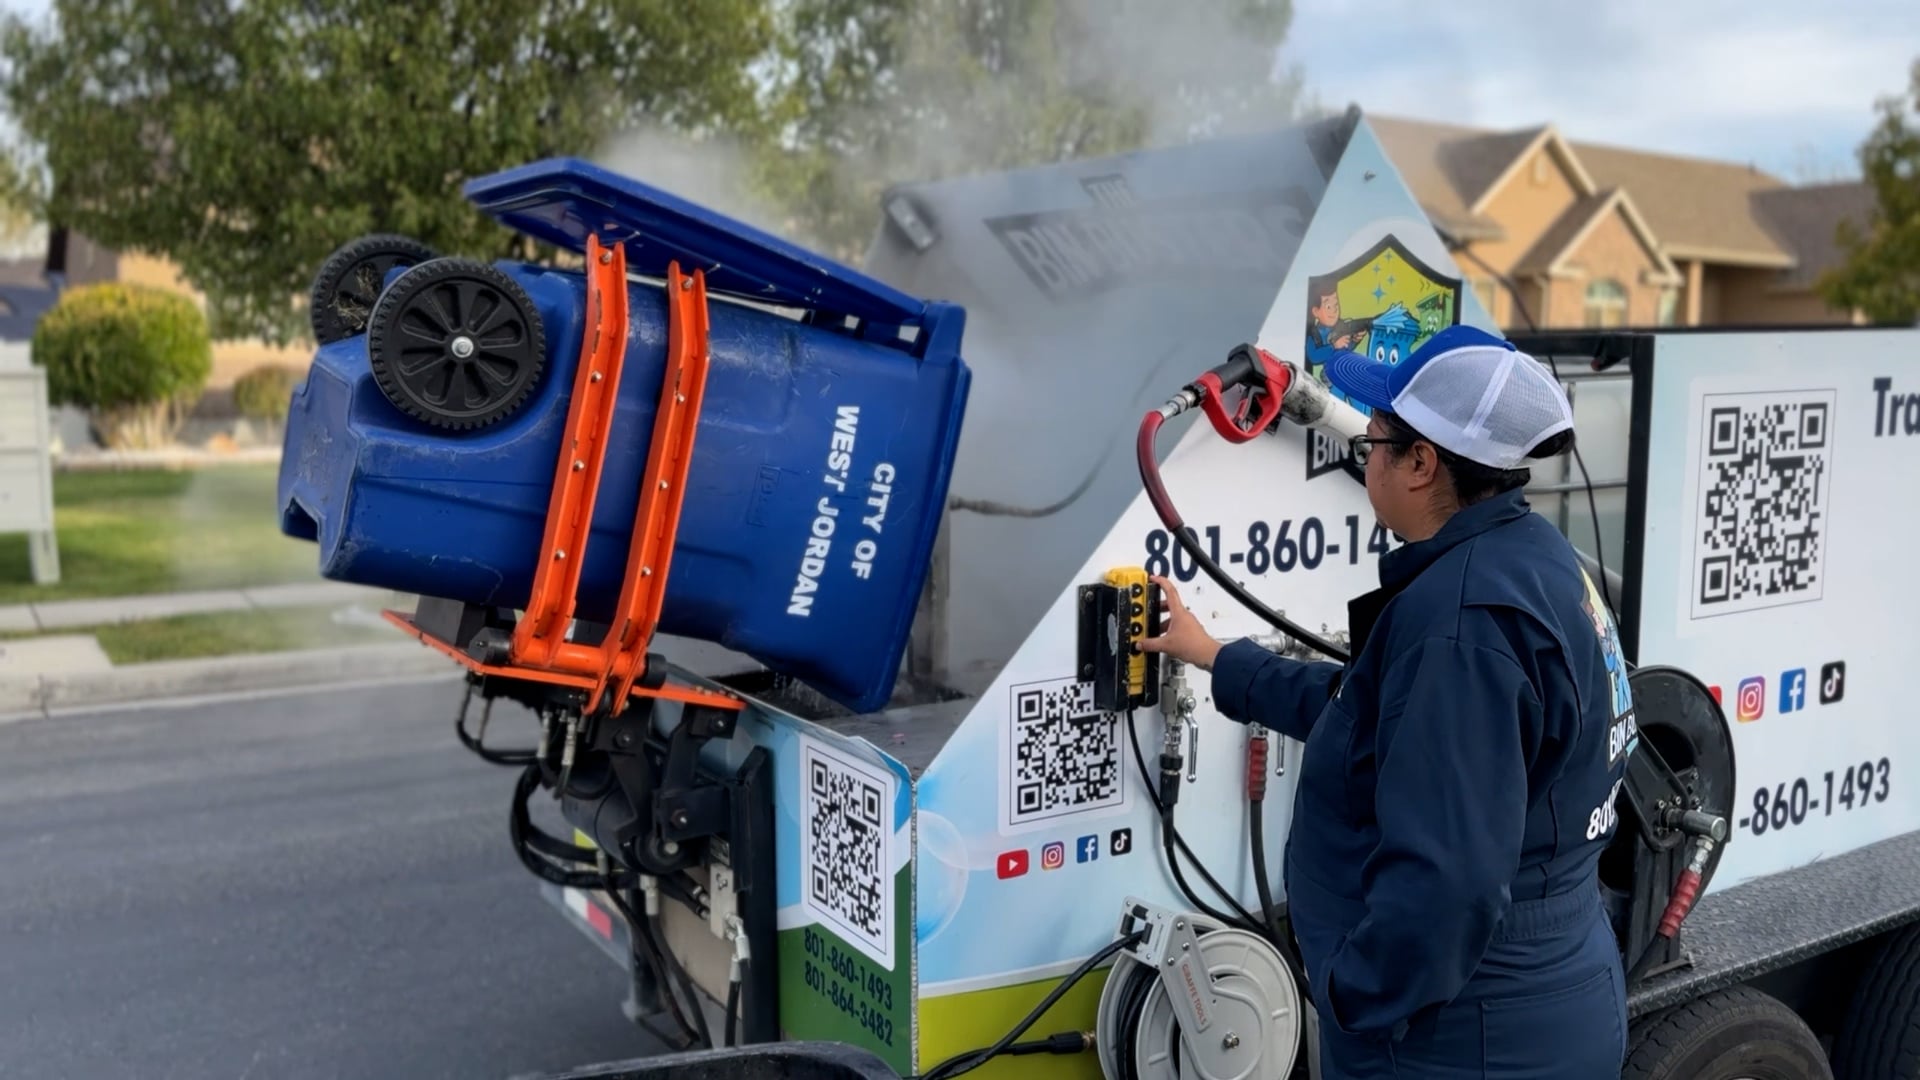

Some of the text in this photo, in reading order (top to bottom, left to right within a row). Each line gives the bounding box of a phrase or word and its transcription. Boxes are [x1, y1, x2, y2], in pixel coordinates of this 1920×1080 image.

[1006, 221, 1106, 291] BIN
[786, 405, 861, 617] WEST JORDAN
[851, 462, 896, 580] CITY OF
[1144, 514, 1406, 583] 801-860-14
[1609, 718, 1627, 763] BIN
[804, 927, 893, 1011] 801-860-1493
[804, 960, 893, 1047] 801-864-3482
